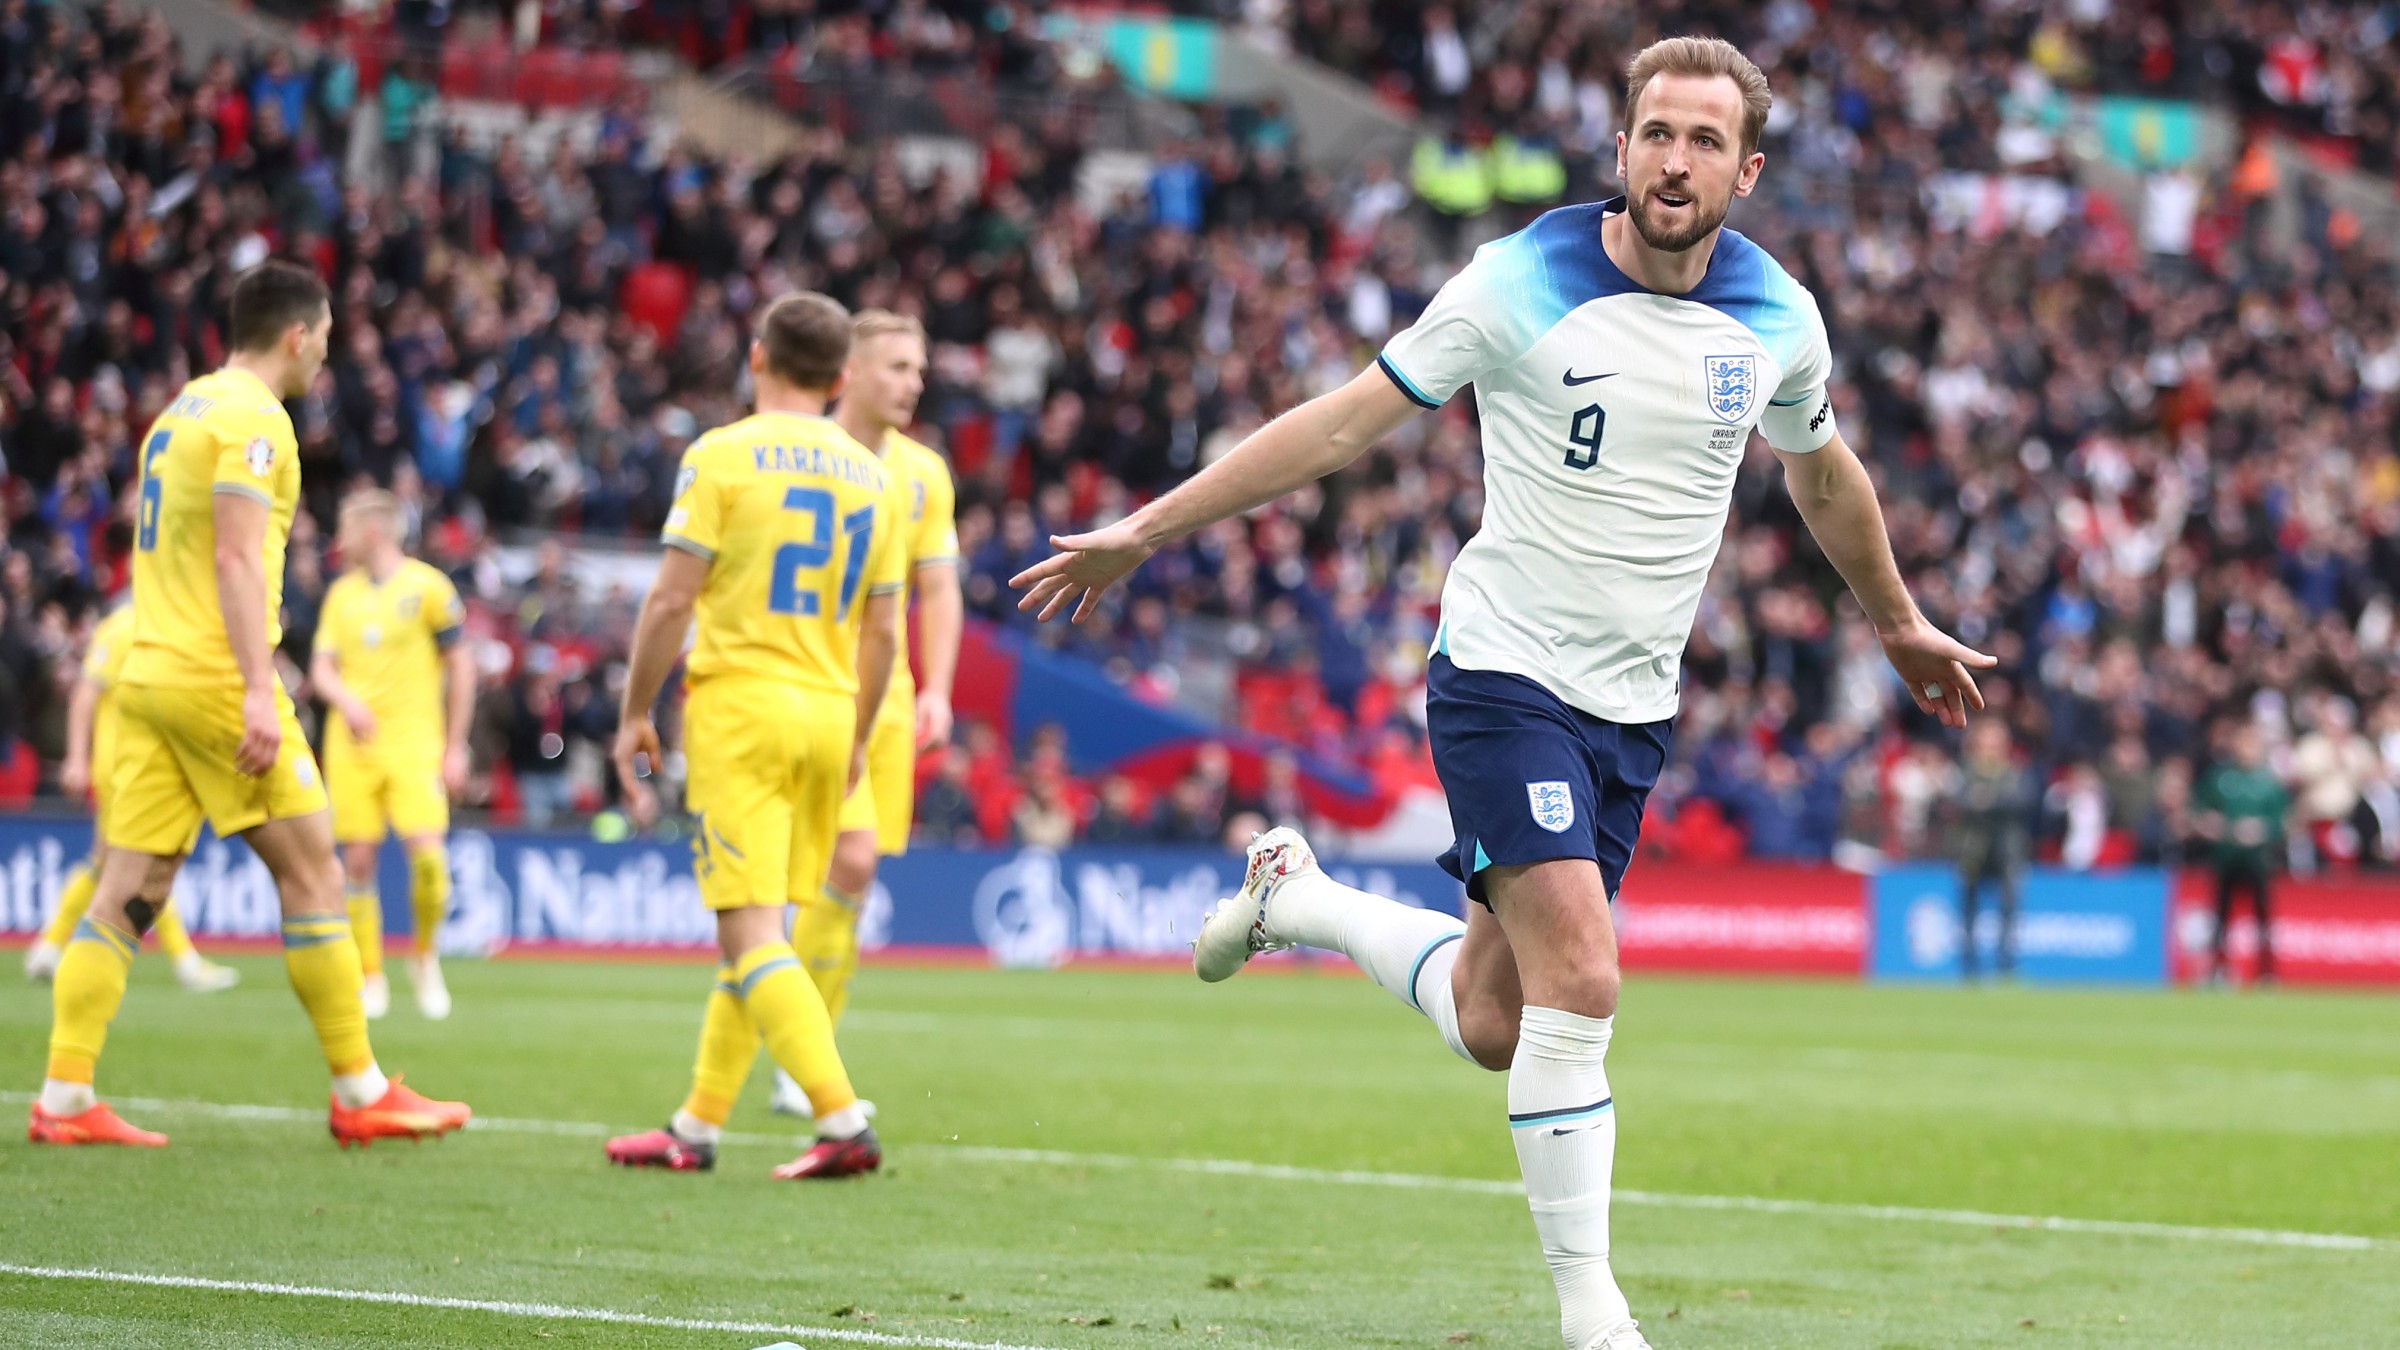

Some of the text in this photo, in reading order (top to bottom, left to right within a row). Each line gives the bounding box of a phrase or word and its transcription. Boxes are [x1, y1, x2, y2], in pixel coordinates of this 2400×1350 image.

[1563, 402, 1606, 471] 9
[1809, 391, 1830, 433] #ON
[139, 430, 171, 552] 6
[767, 485, 875, 622] 21
